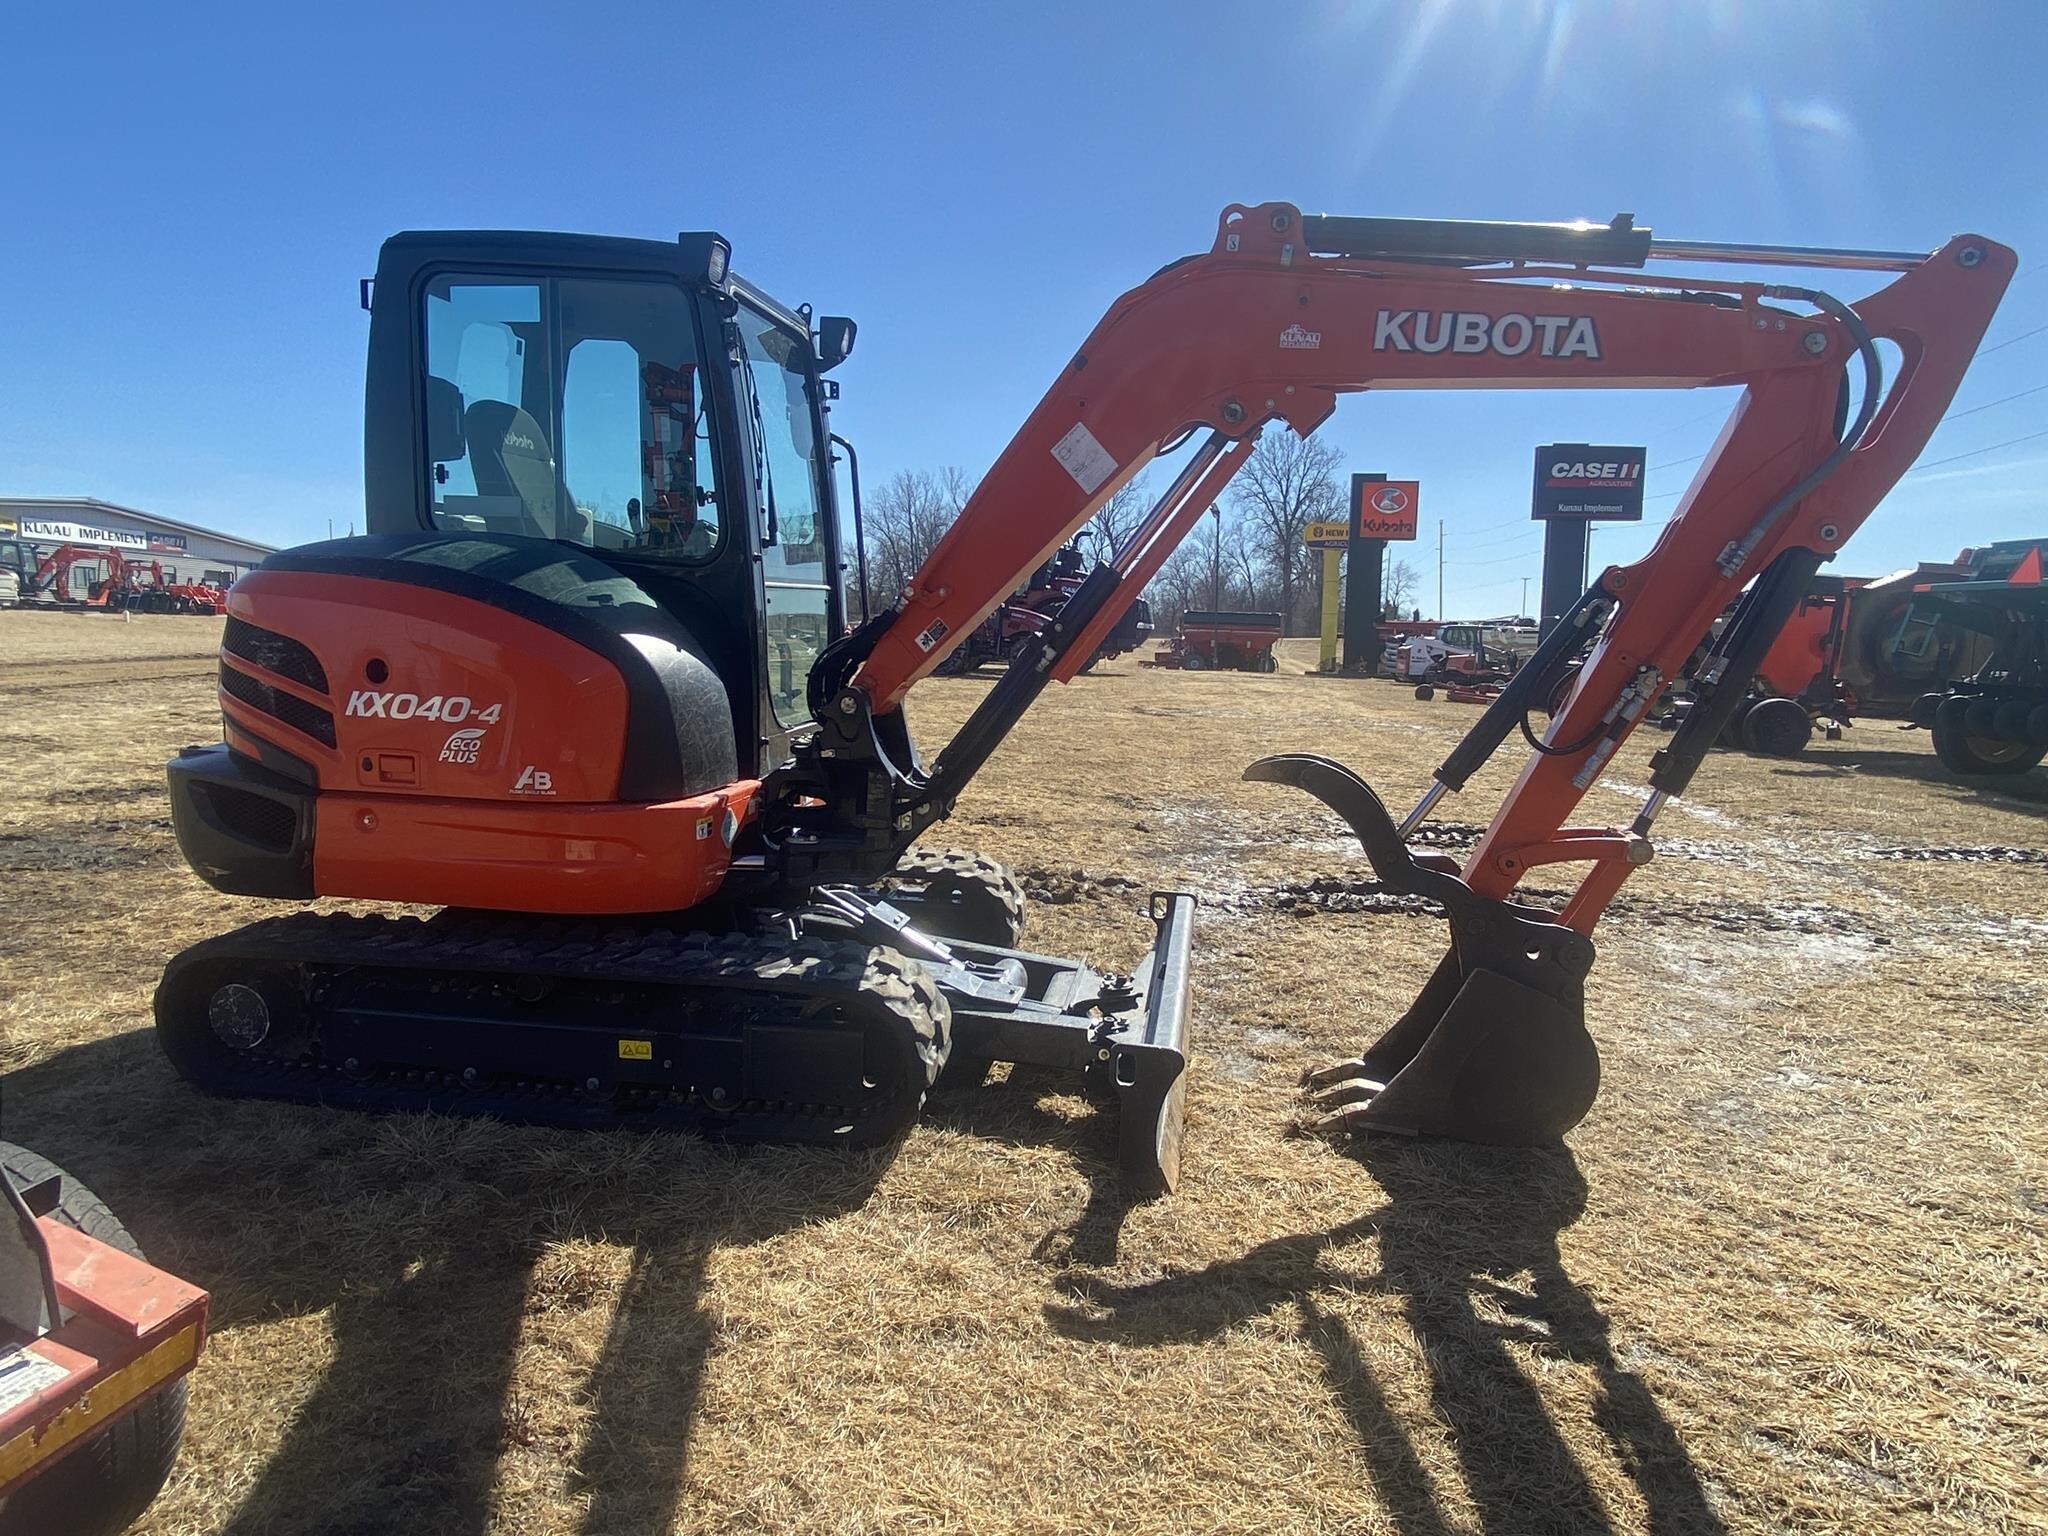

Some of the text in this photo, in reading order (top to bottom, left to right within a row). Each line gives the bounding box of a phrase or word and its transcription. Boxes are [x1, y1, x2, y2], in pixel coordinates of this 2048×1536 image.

[1280, 331, 1321, 343] KUNAU
[1373, 310, 1600, 358] KUBOTA
[1551, 462, 1618, 479] CASE
[1558, 503, 1623, 513] Kunau Implement
[1325, 529, 1345, 537] NEW
[1363, 519, 1413, 533] Kubota
[24, 521, 146, 546] KUNAU IMPLEMENT
[344, 690, 503, 725] KX040-4
[450, 738, 481, 752] eco
[438, 750, 479, 764] PLUS
